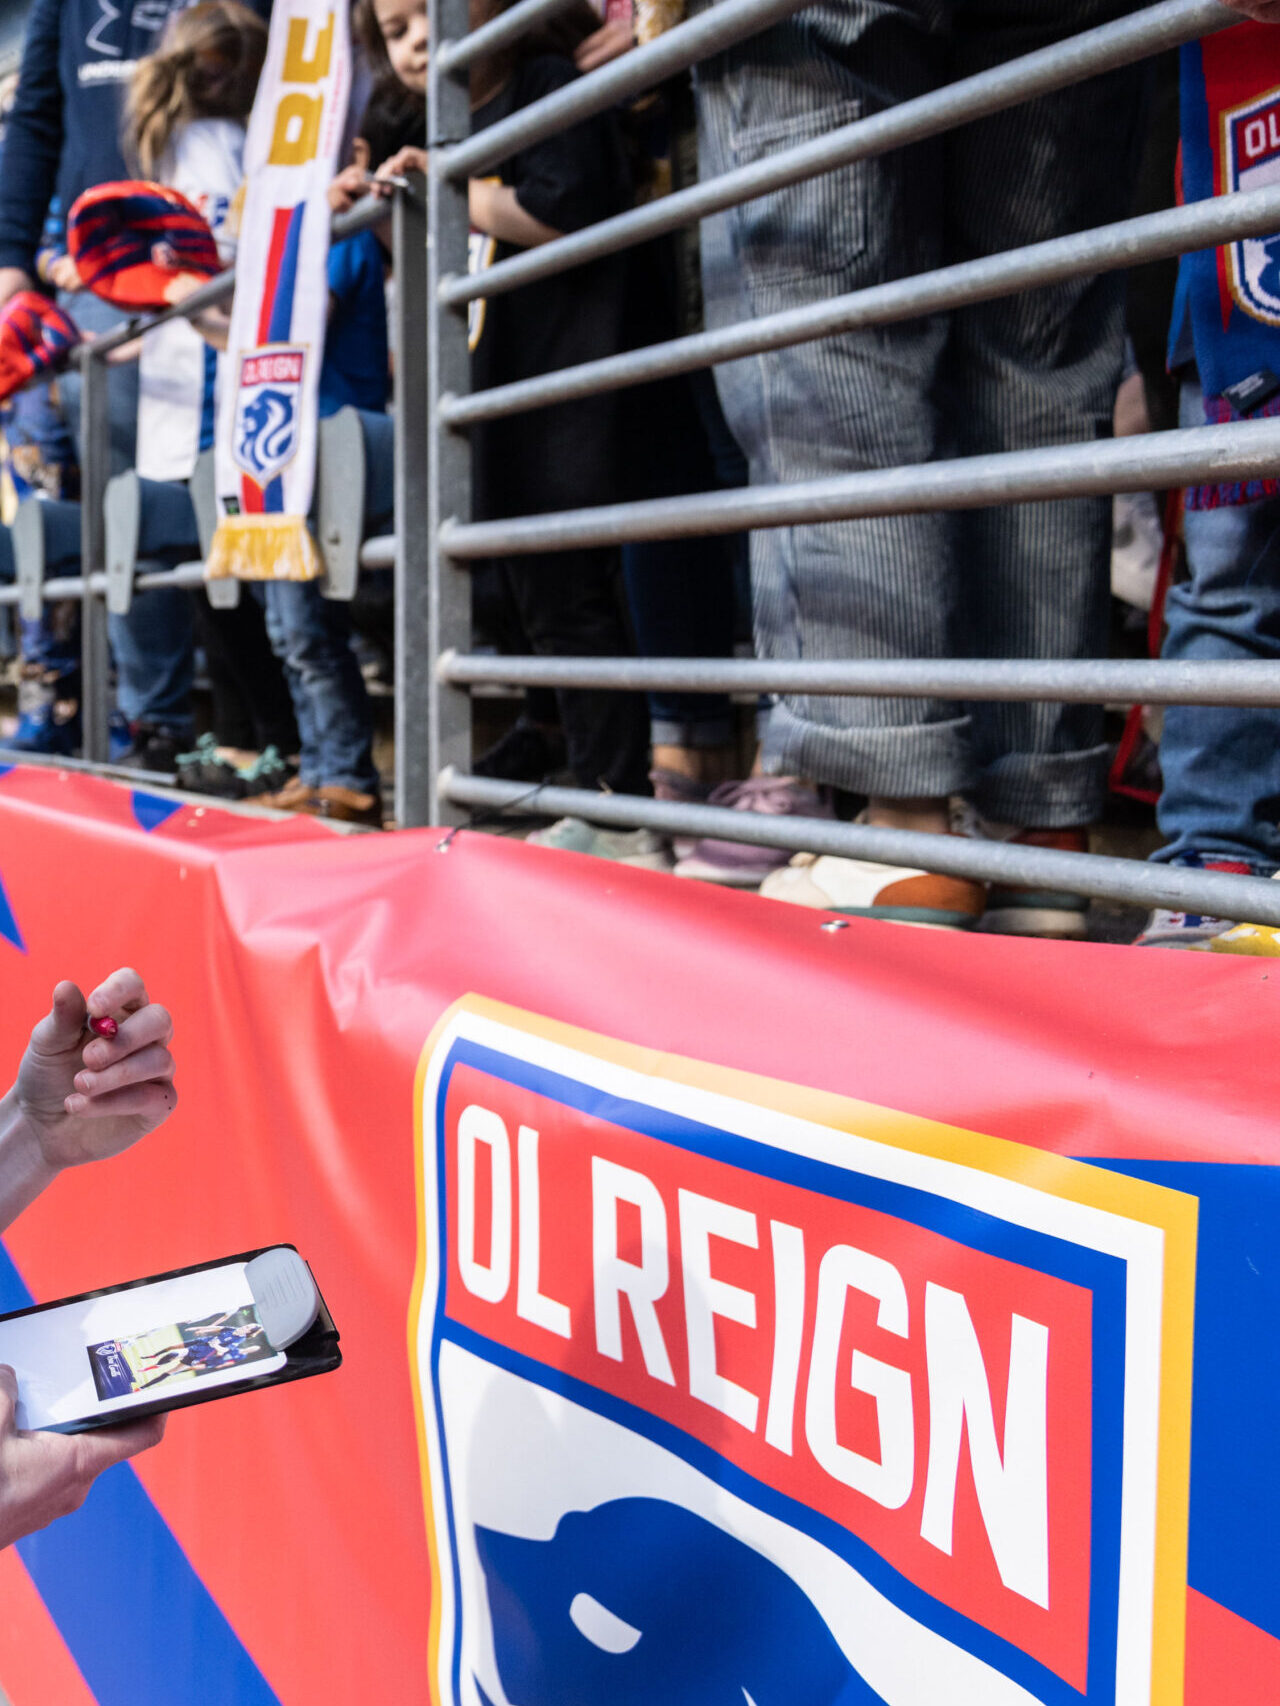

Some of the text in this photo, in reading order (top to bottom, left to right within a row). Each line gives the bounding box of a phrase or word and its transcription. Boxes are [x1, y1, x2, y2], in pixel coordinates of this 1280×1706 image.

[1245, 112, 1280, 158] OL
[457, 1104, 1050, 1612] OL REIGN
